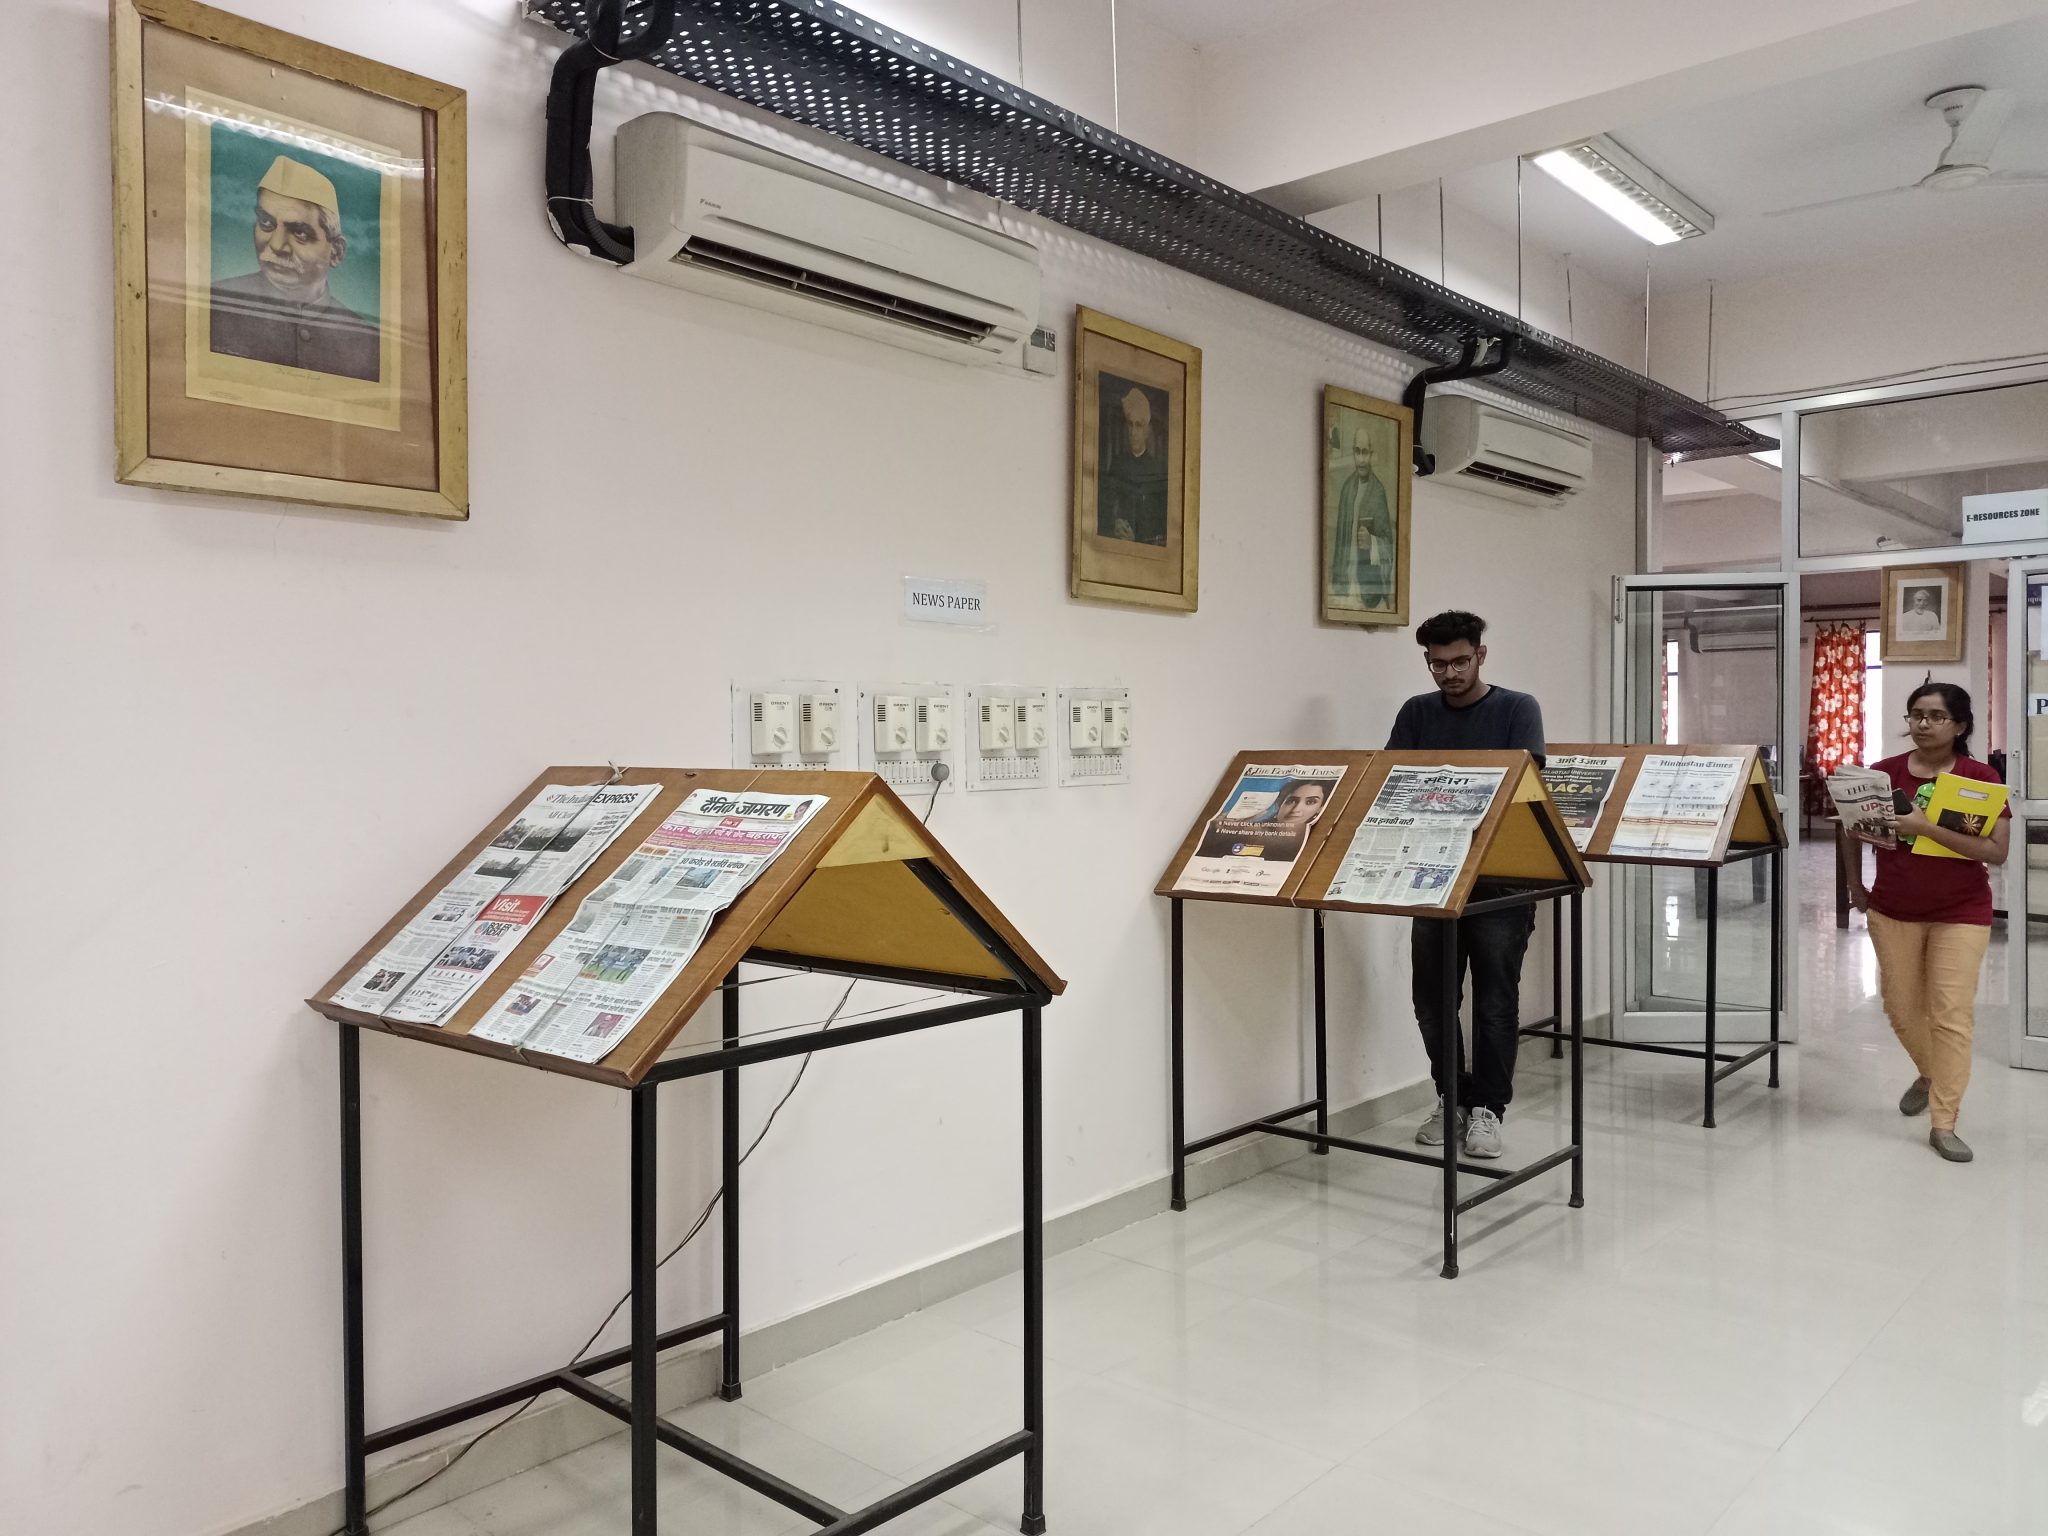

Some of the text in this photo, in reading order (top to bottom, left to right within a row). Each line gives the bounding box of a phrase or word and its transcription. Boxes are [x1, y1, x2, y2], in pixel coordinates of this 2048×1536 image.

[1966, 508, 2040, 522] E-RESOURCES ZONE
[912, 592, 981, 611] NEWS PAPER
[1660, 760, 1734, 769] Hindustan Times
[1423, 776, 1469, 785] सहारा
[1846, 784, 1869, 795] THE
[592, 793, 638, 804] EXPRESS
[700, 797, 791, 817] दैनिक जागरण
[1378, 816, 1399, 825] इनकी
[492, 898, 521, 912] Visit
